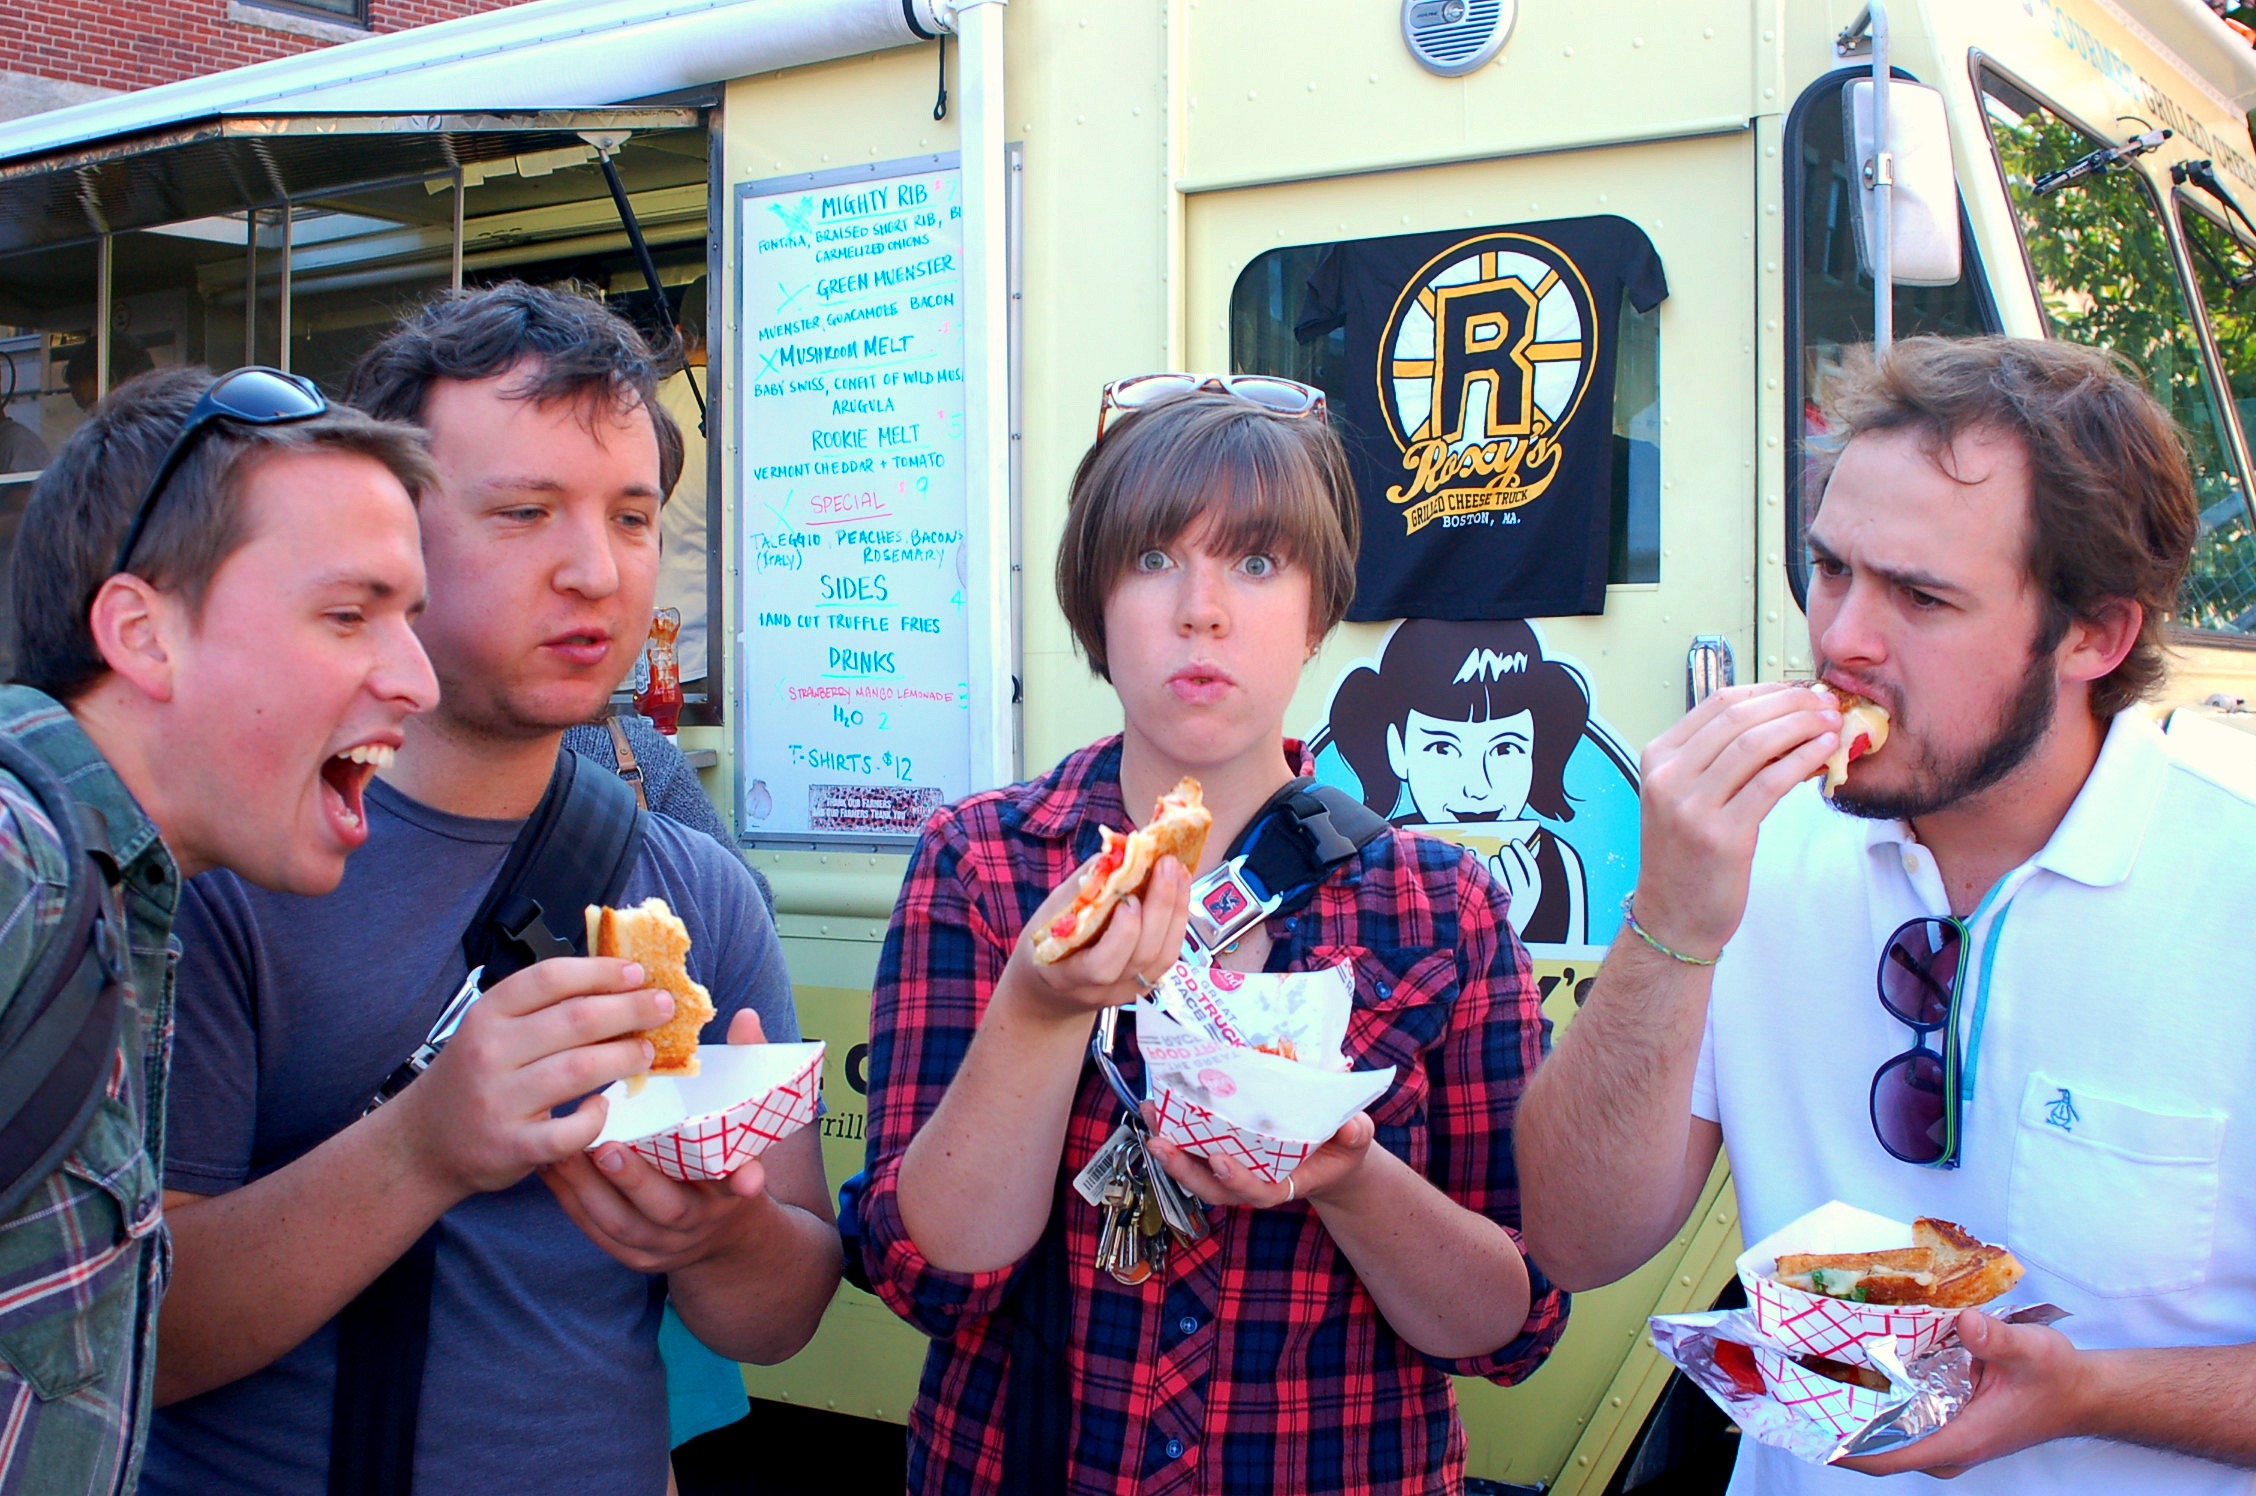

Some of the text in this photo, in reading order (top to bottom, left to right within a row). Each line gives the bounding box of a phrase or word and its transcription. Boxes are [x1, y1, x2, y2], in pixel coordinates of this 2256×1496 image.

[2140, 76, 2213, 157] GRILLED
[821, 186, 888, 219] MIGHTY
[898, 184, 928, 207] RIB
[815, 225, 869, 243] BRAISED
[873, 218, 908, 236] SHORT
[815, 234, 930, 263] CARMELIZED ONIONS
[816, 254, 956, 300] GREEN MUENSTER
[827, 302, 899, 327] GUACAMOLE
[910, 292, 954, 311] BACON
[780, 335, 915, 367] MUSHROOM MELT
[1431, 275, 1539, 443] R
[754, 380, 785, 397] BABY
[883, 372, 899, 387] OF
[903, 370, 934, 385] WILD
[832, 397, 895, 415] ARUGULA
[812, 428, 869, 451] ROOKIE
[878, 424, 920, 448] MELT
[753, 461, 810, 480] VERMONT
[814, 458, 875, 476] CHEDDAR
[892, 452, 945, 468] TOMATO
[1386, 421, 1563, 504] Roxy's
[810, 491, 886, 514] SPECIAL
[1411, 489, 1528, 528] GRILLED CHEESE TRUCK
[863, 547, 945, 568] ROSEMARY
[820, 574, 888, 601] SIDES
[798, 615, 820, 628] CUT
[828, 614, 889, 631] TRUFFLE
[901, 616, 941, 634] FRIES
[829, 646, 895, 674] DRINKS
[788, 686, 851, 704] STRAWBERRY
[856, 687, 894, 701] MANGO
[897, 687, 954, 702] LEMONADE
[878, 712, 891, 731] 2
[1170, 975, 1207, 1021] RACE
[1201, 980, 1238, 1022] GREAT
[1198, 992, 1248, 1048] TRUCK
